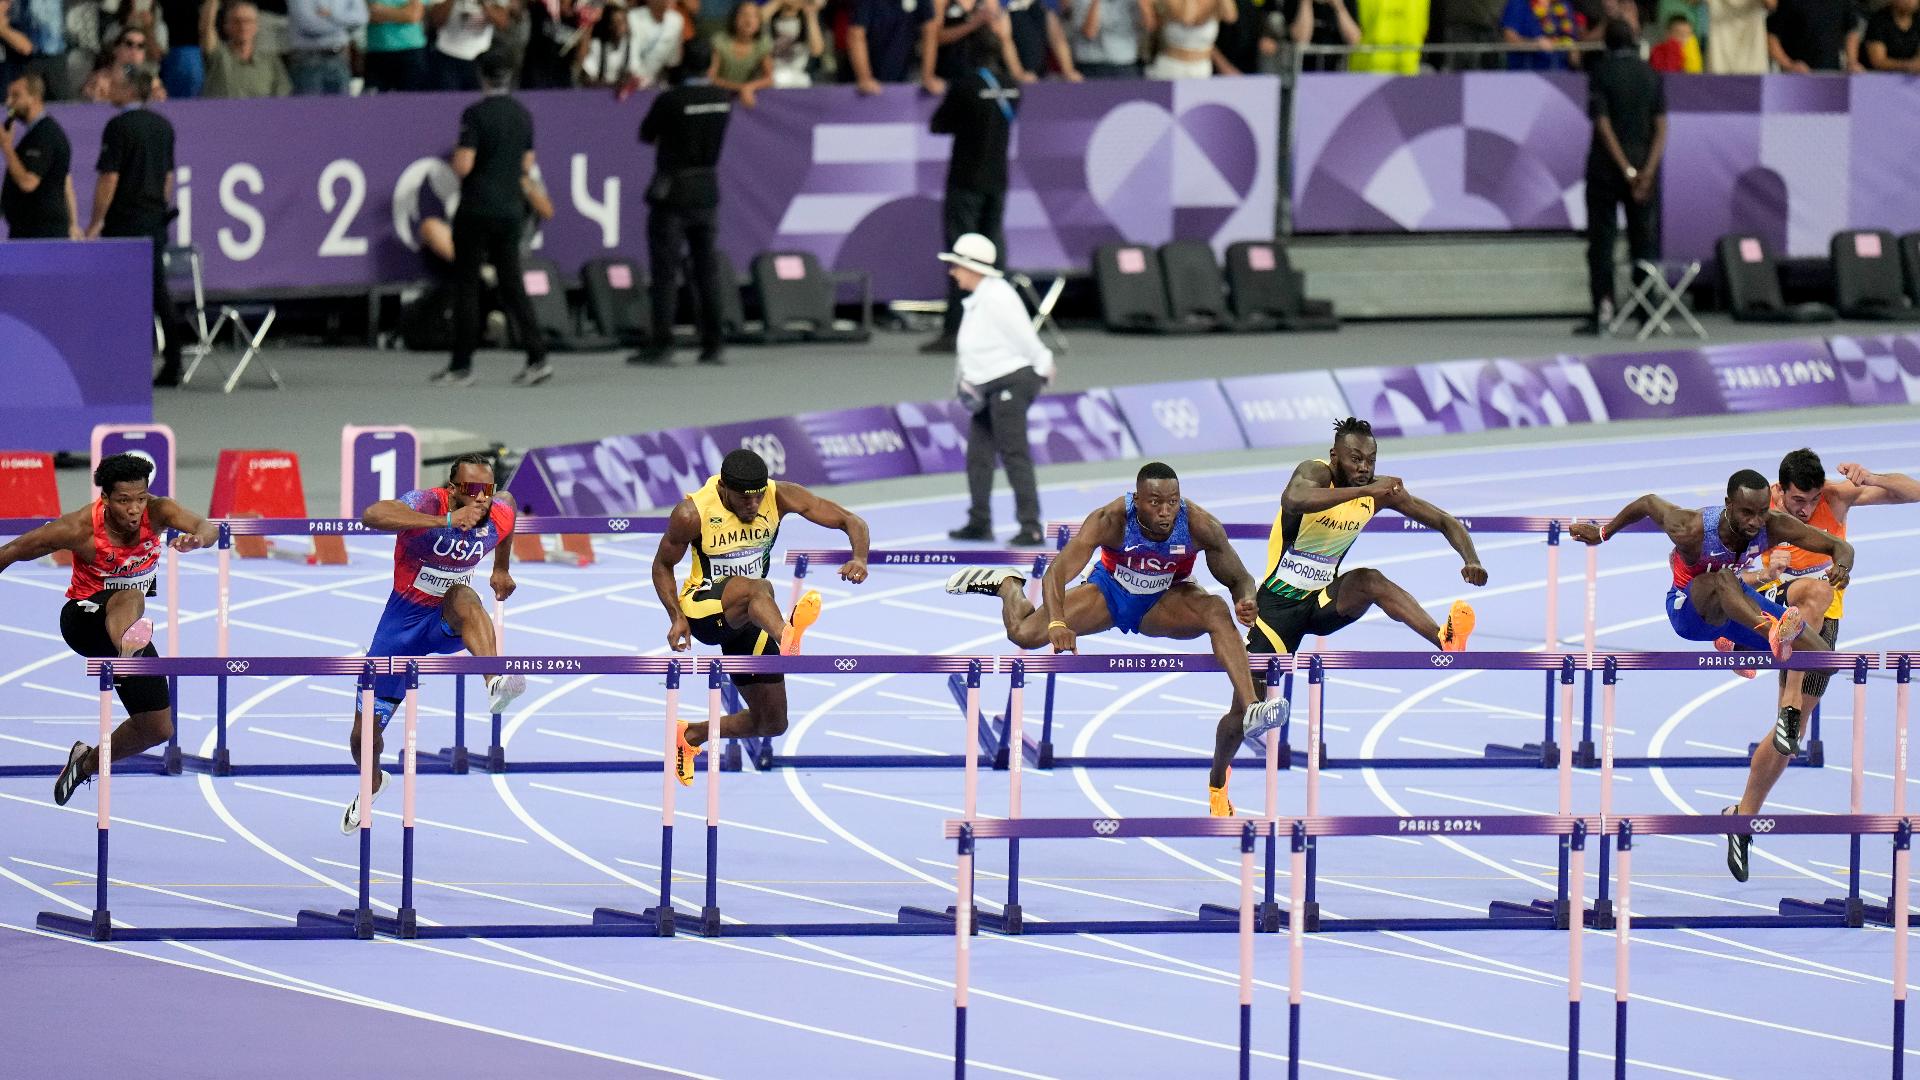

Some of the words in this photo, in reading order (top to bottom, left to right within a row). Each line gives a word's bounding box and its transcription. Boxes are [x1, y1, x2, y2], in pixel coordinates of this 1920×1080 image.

[318, 153, 620, 260] 204
[370, 449, 396, 501] 1
[1315, 515, 1360, 531] JAMAICA
[709, 528, 770, 548] JAMAICA
[432, 535, 484, 561] USA
[713, 557, 763, 576] BENNETT
[923, 554, 956, 563] 2024
[1116, 567, 1172, 589] HOLLOWAY
[1281, 558, 1332, 582] BROADBELL
[547, 660, 581, 670] 2024
[1150, 658, 1184, 668] 2024
[1739, 655, 1772, 666] 2024
[677, 746, 685, 777] NITRO
[1444, 819, 1481, 831] 2024
